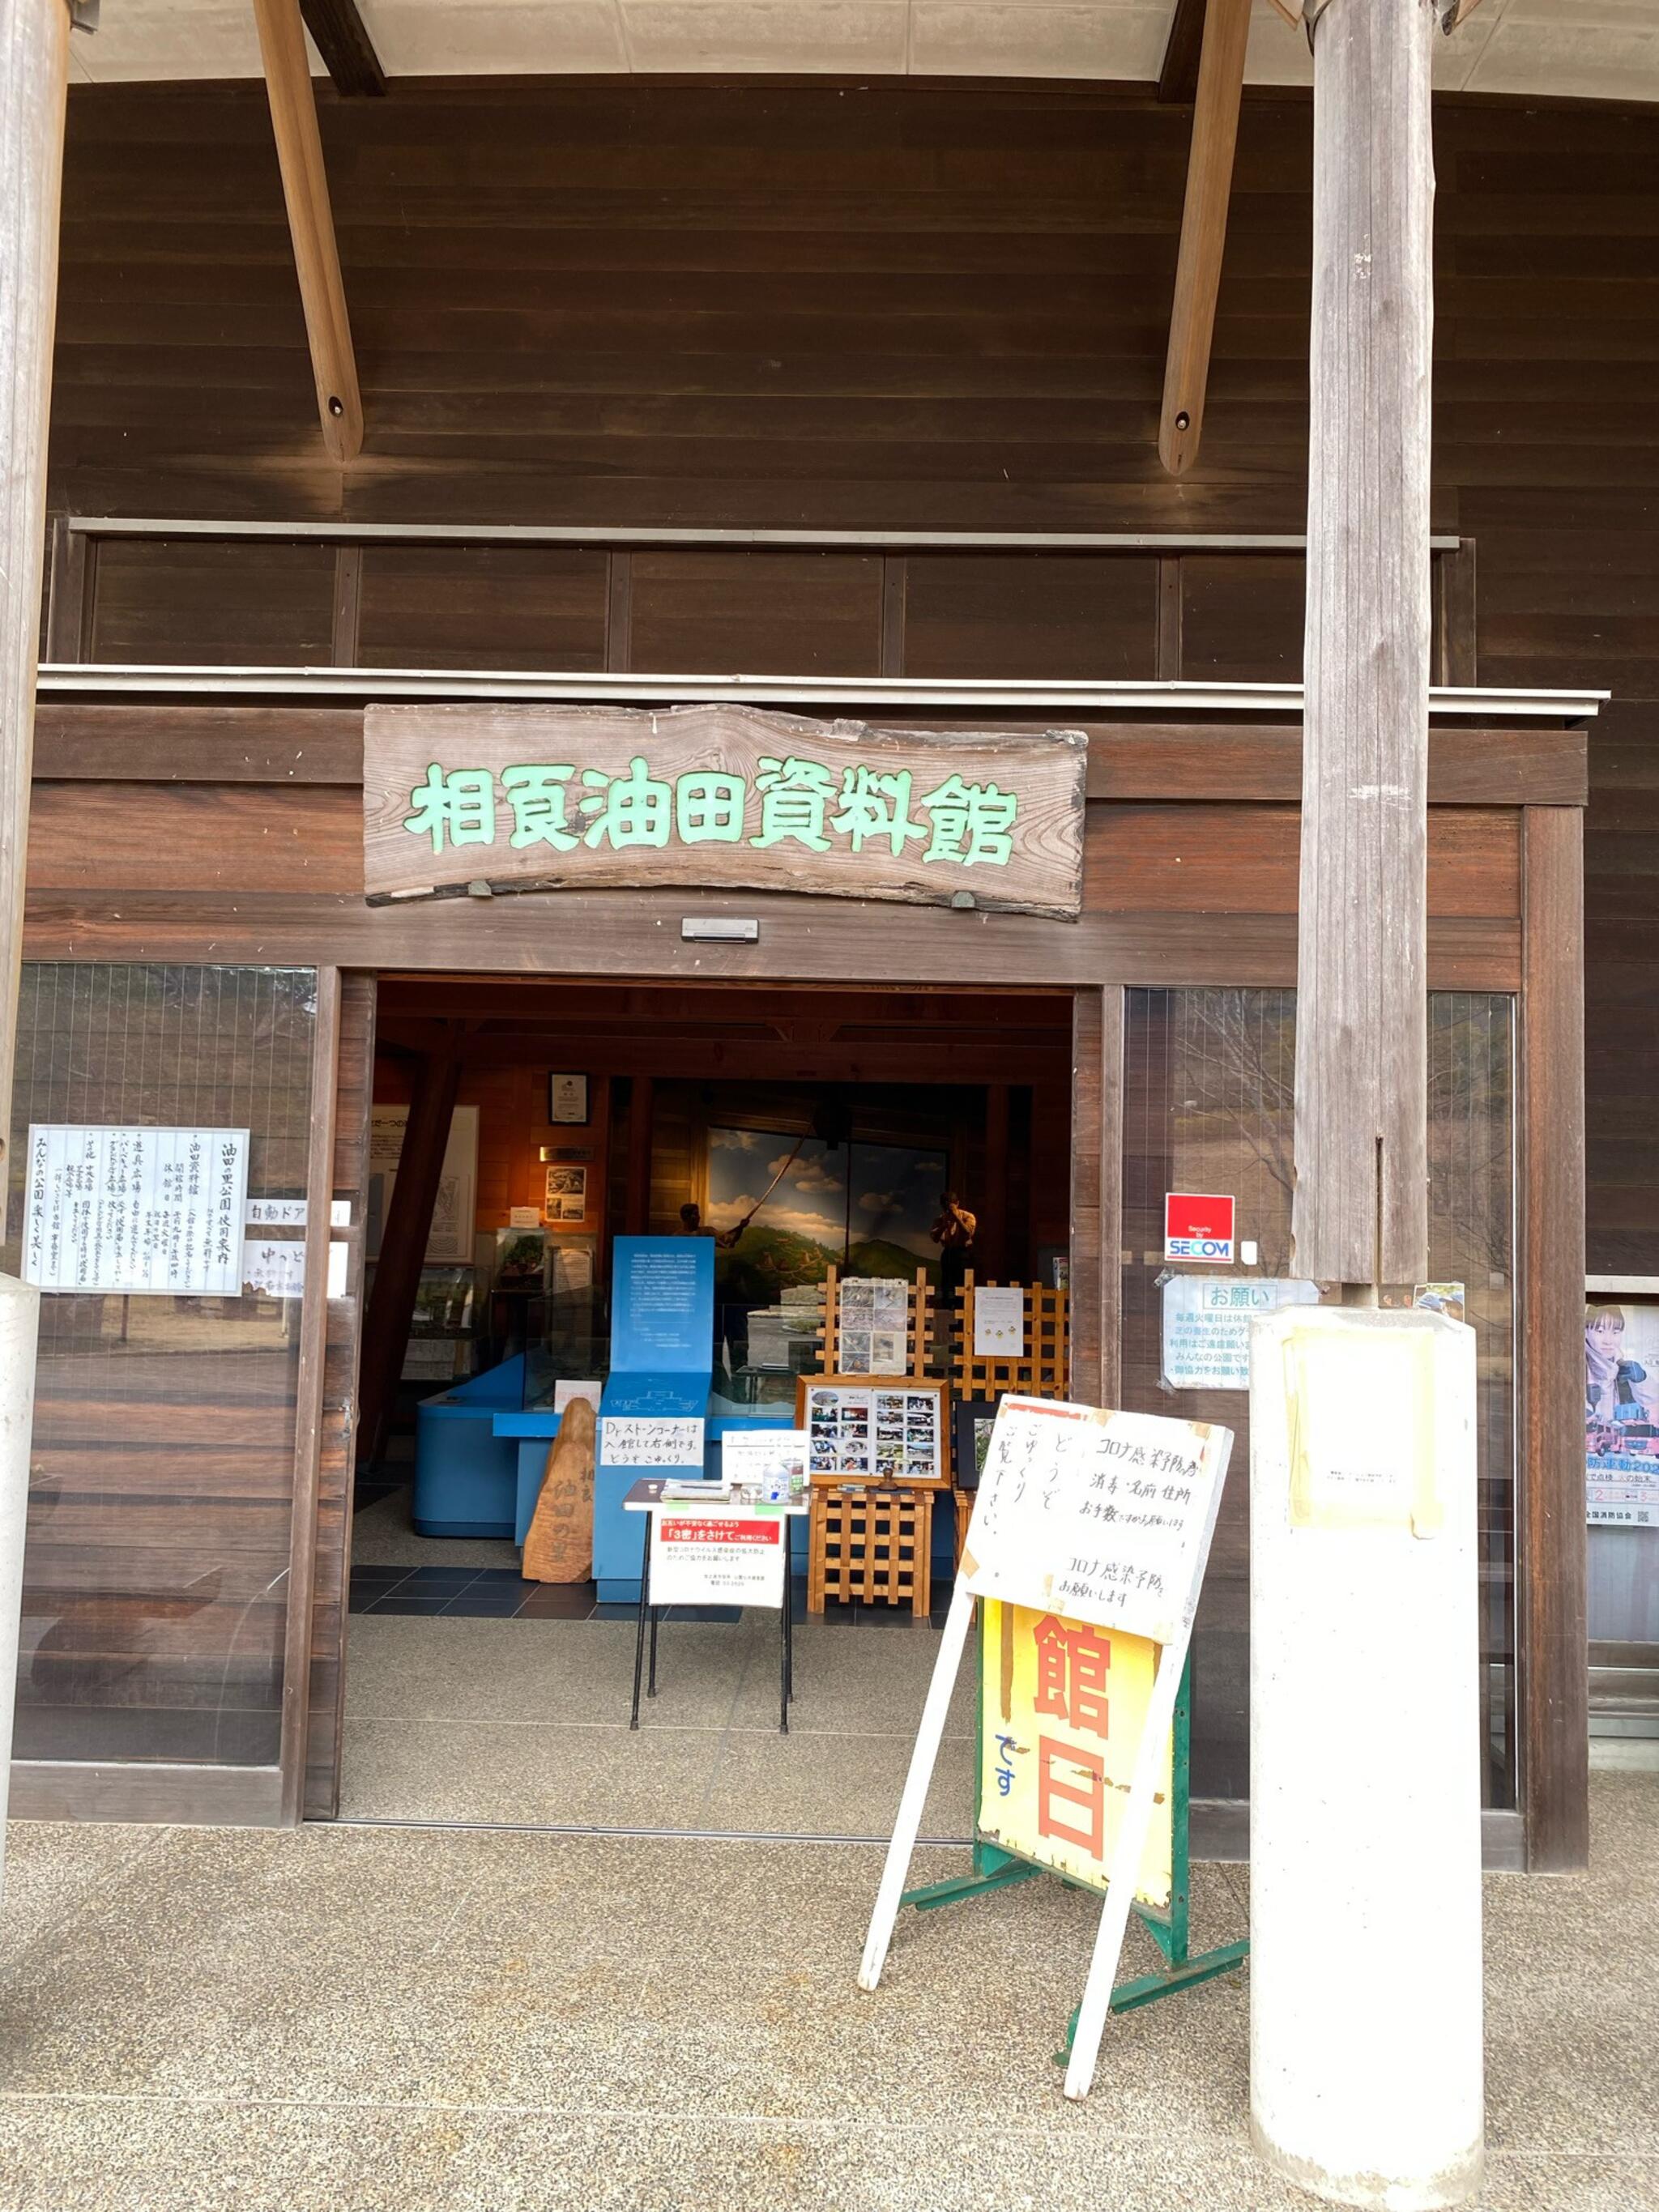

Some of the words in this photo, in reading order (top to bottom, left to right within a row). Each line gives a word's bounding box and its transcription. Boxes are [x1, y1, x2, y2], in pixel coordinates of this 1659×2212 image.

[253, 1204, 305, 1220] 自動ドア
[1188, 1225, 1212, 1234] Security
[1170, 1240, 1229, 1256] SECOM
[1211, 1286, 1269, 1306] お願い
[1043, 1432, 1073, 1510] どうぞ
[1162, 1484, 1192, 1505] 住所
[1059, 1580, 1128, 1607] お願いします
[995, 1733, 1017, 1796] です
